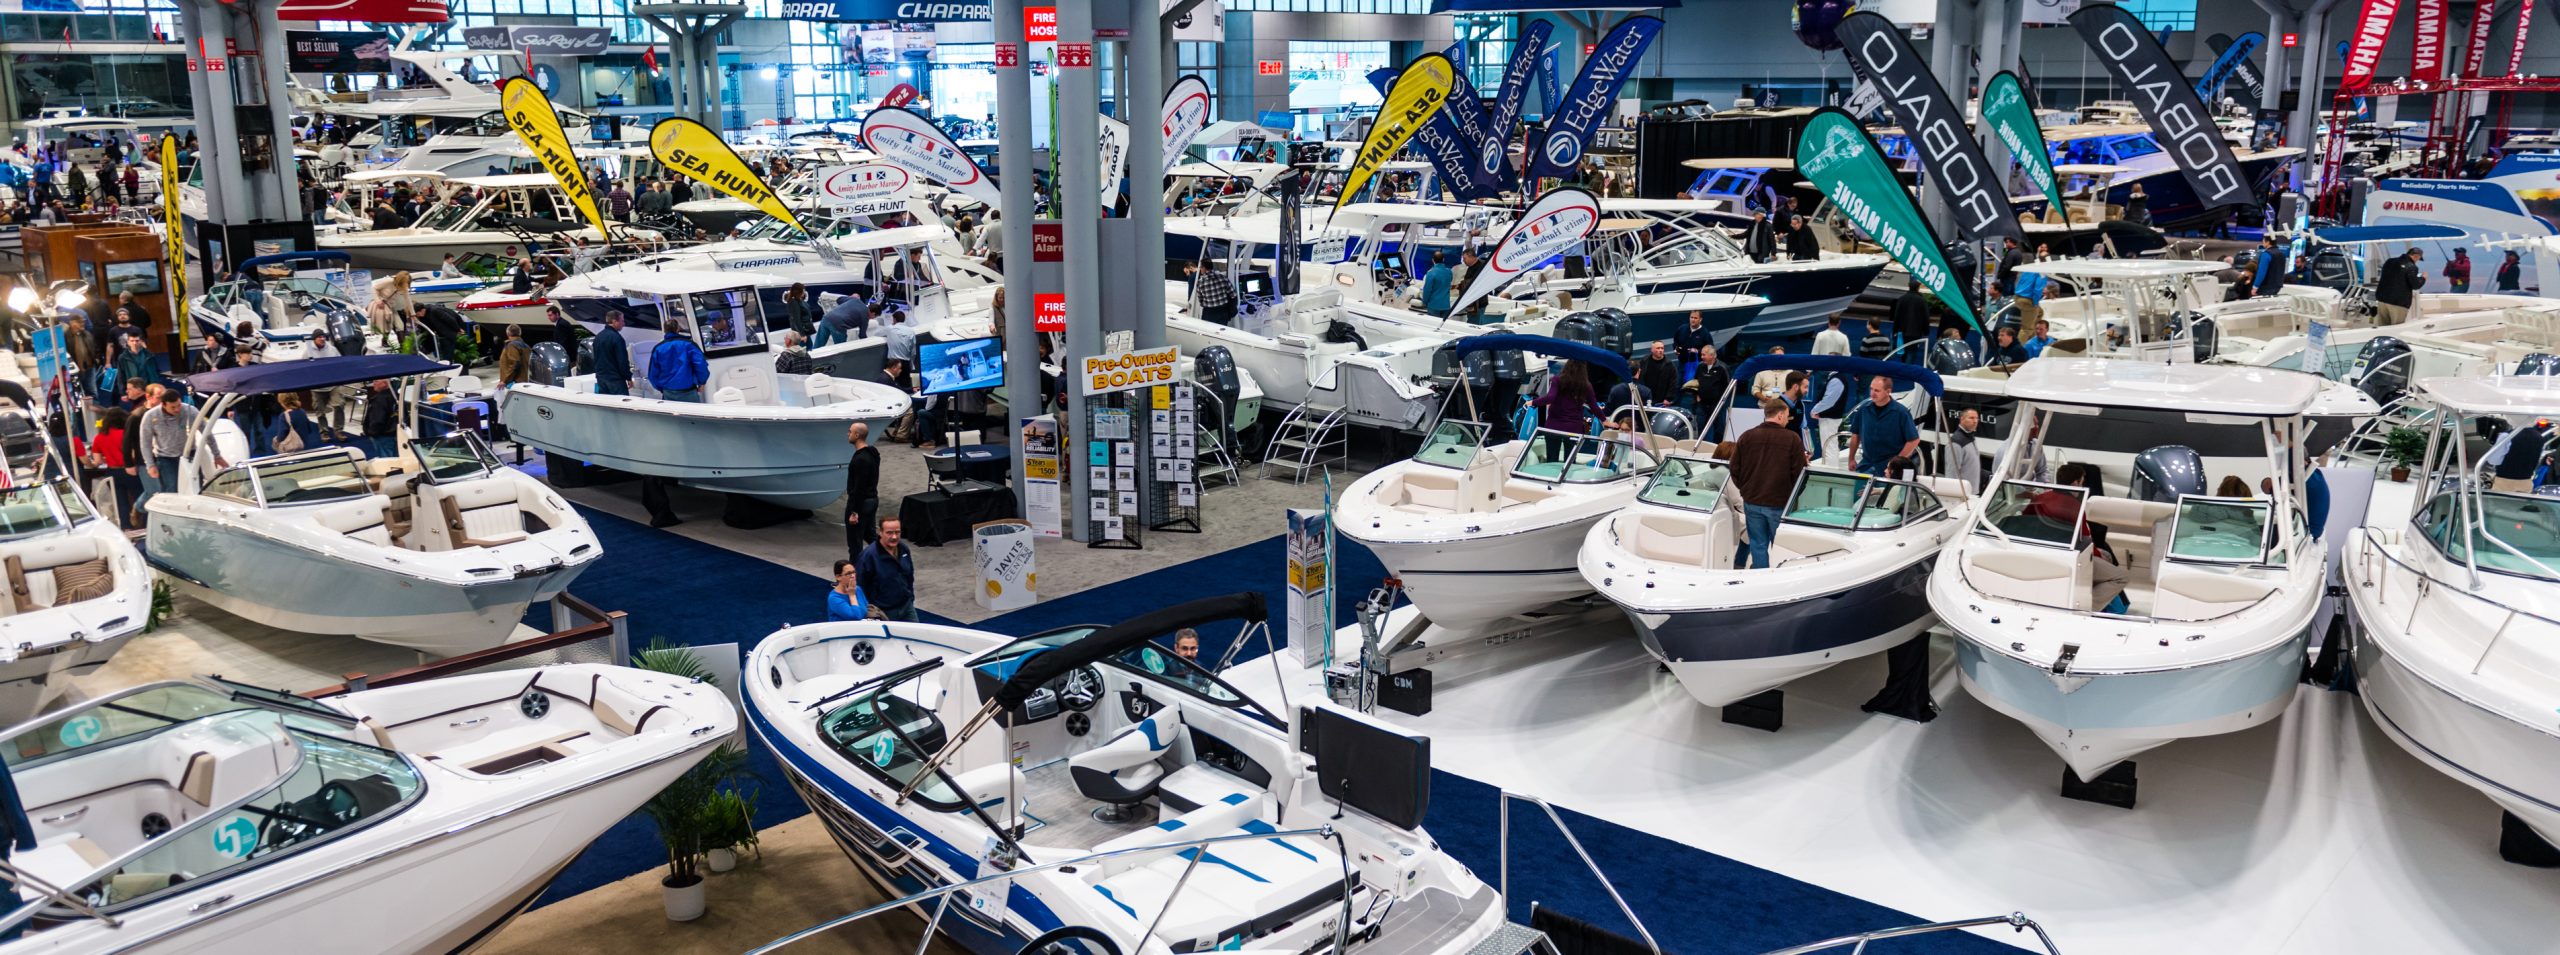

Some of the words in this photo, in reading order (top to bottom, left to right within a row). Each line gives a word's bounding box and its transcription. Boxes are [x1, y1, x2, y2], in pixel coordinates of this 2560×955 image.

[782, 3, 840, 18] ARRAL
[897, 3, 990, 19] CHAPARR
[1033, 13, 1056, 23] FIRE
[1030, 26, 1057, 36] HOSE
[2468, 3, 2493, 72] YAMAHA
[296, 41, 312, 53] BEST
[313, 41, 340, 53] SELLING
[2509, 9, 2532, 72] YAMAHA
[1259, 61, 1282, 74] Exit
[1493, 29, 1543, 140] EdgeWater
[1564, 25, 1644, 134] EdgeWater
[512, 110, 544, 148] SEA
[543, 147, 589, 200] HUNT
[871, 131, 900, 150] Amity
[903, 143, 933, 163] Harbor
[936, 159, 967, 178] Marine
[668, 148, 710, 176] SEA
[712, 169, 772, 205] HUNT
[901, 159, 926, 175] SERVICE
[926, 170, 948, 184] MARINA
[836, 184, 856, 194] Amity
[855, 182, 878, 191] Harbor
[878, 180, 901, 188] Marine
[2401, 182, 2436, 191] Reliability
[854, 204, 875, 214] SEA
[879, 201, 906, 212] HUNT
[2394, 202, 2434, 212] YAMAHA
[1034, 234, 1056, 243] Fire
[733, 256, 800, 269] CHAPARRAL
[1044, 303, 1066, 311] FIRE
[1037, 315, 1066, 324] ALAR
[1087, 348, 1177, 374] Pre-Owned
[1093, 365, 1173, 390] BOATS
[1026, 458, 1032, 466] 5
[994, 540, 1024, 576] JAVITS
